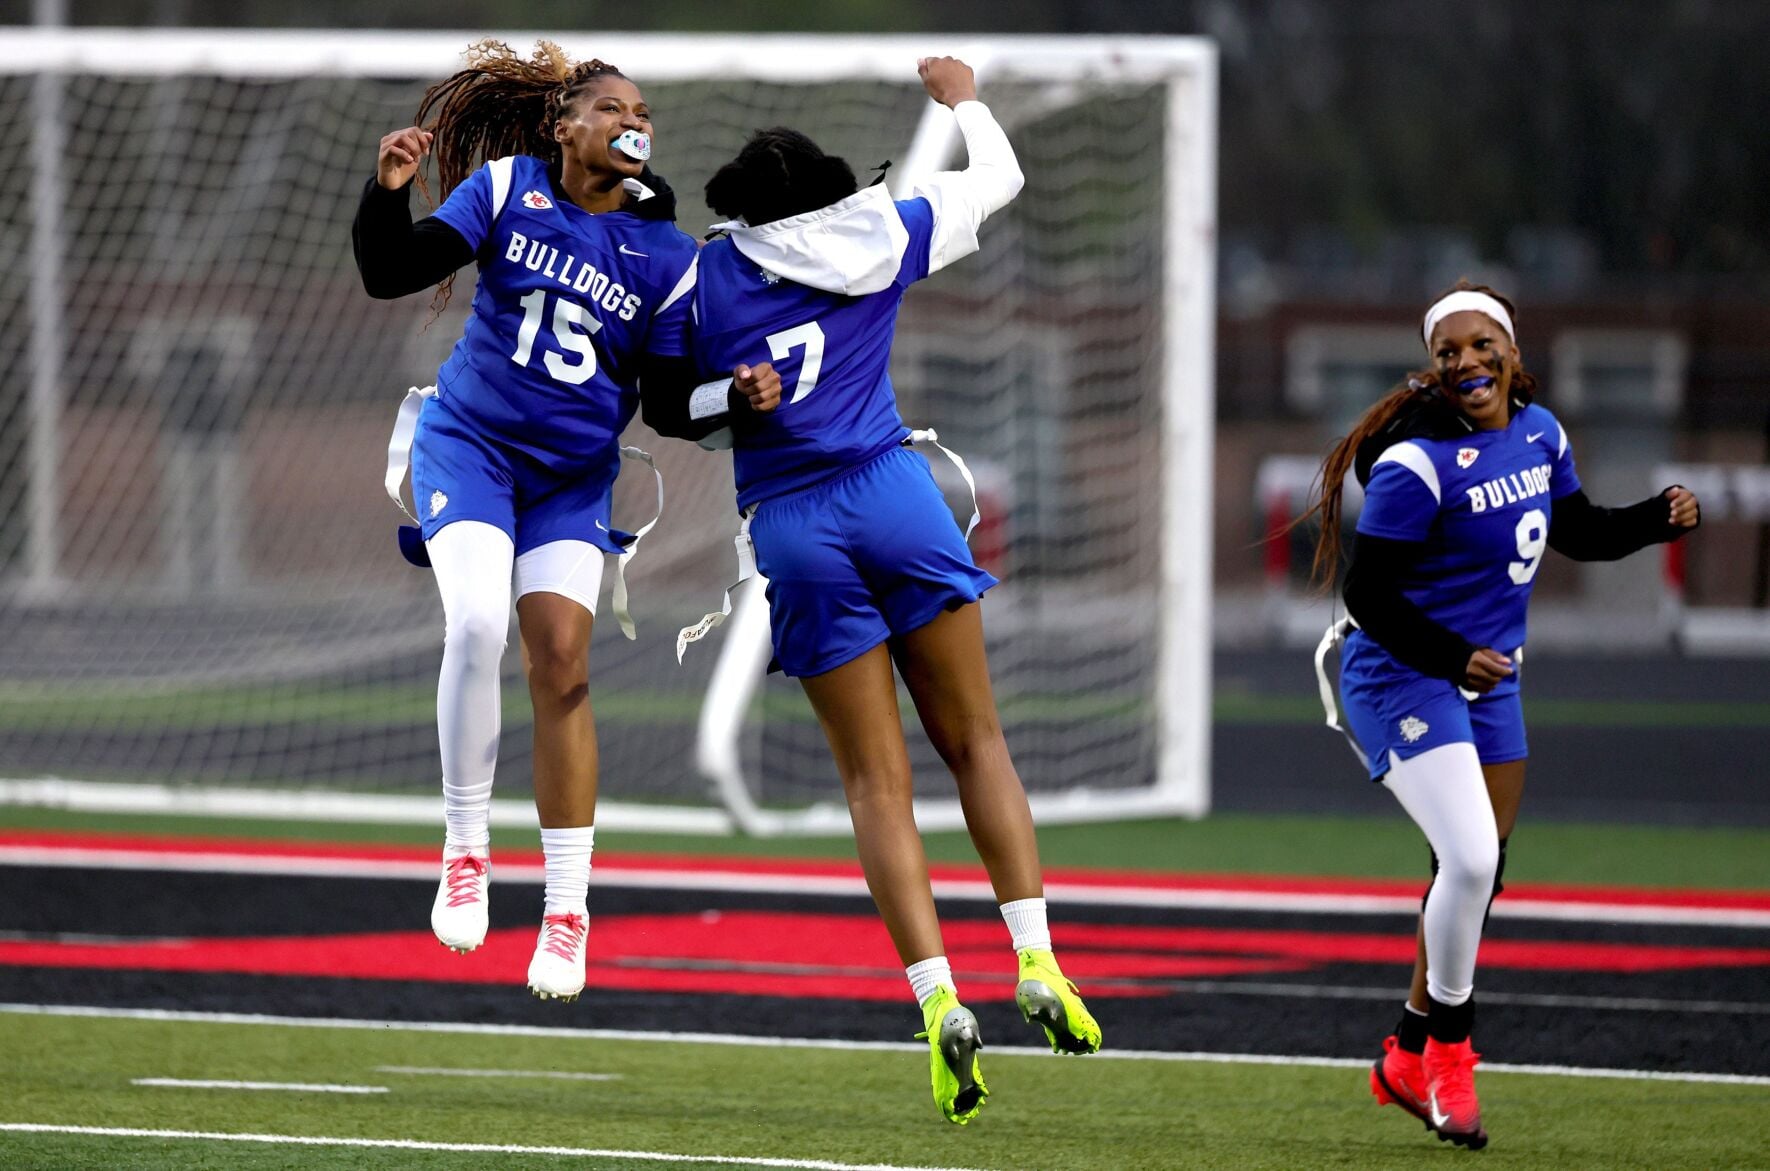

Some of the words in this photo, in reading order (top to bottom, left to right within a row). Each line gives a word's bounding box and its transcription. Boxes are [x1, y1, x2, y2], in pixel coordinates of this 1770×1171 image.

[505, 231, 642, 321] BULLDOGS
[511, 289, 603, 385] 15
[765, 320, 826, 404] 7
[1466, 463, 1552, 513] BULLDOG
[1508, 509, 1548, 585] 9
